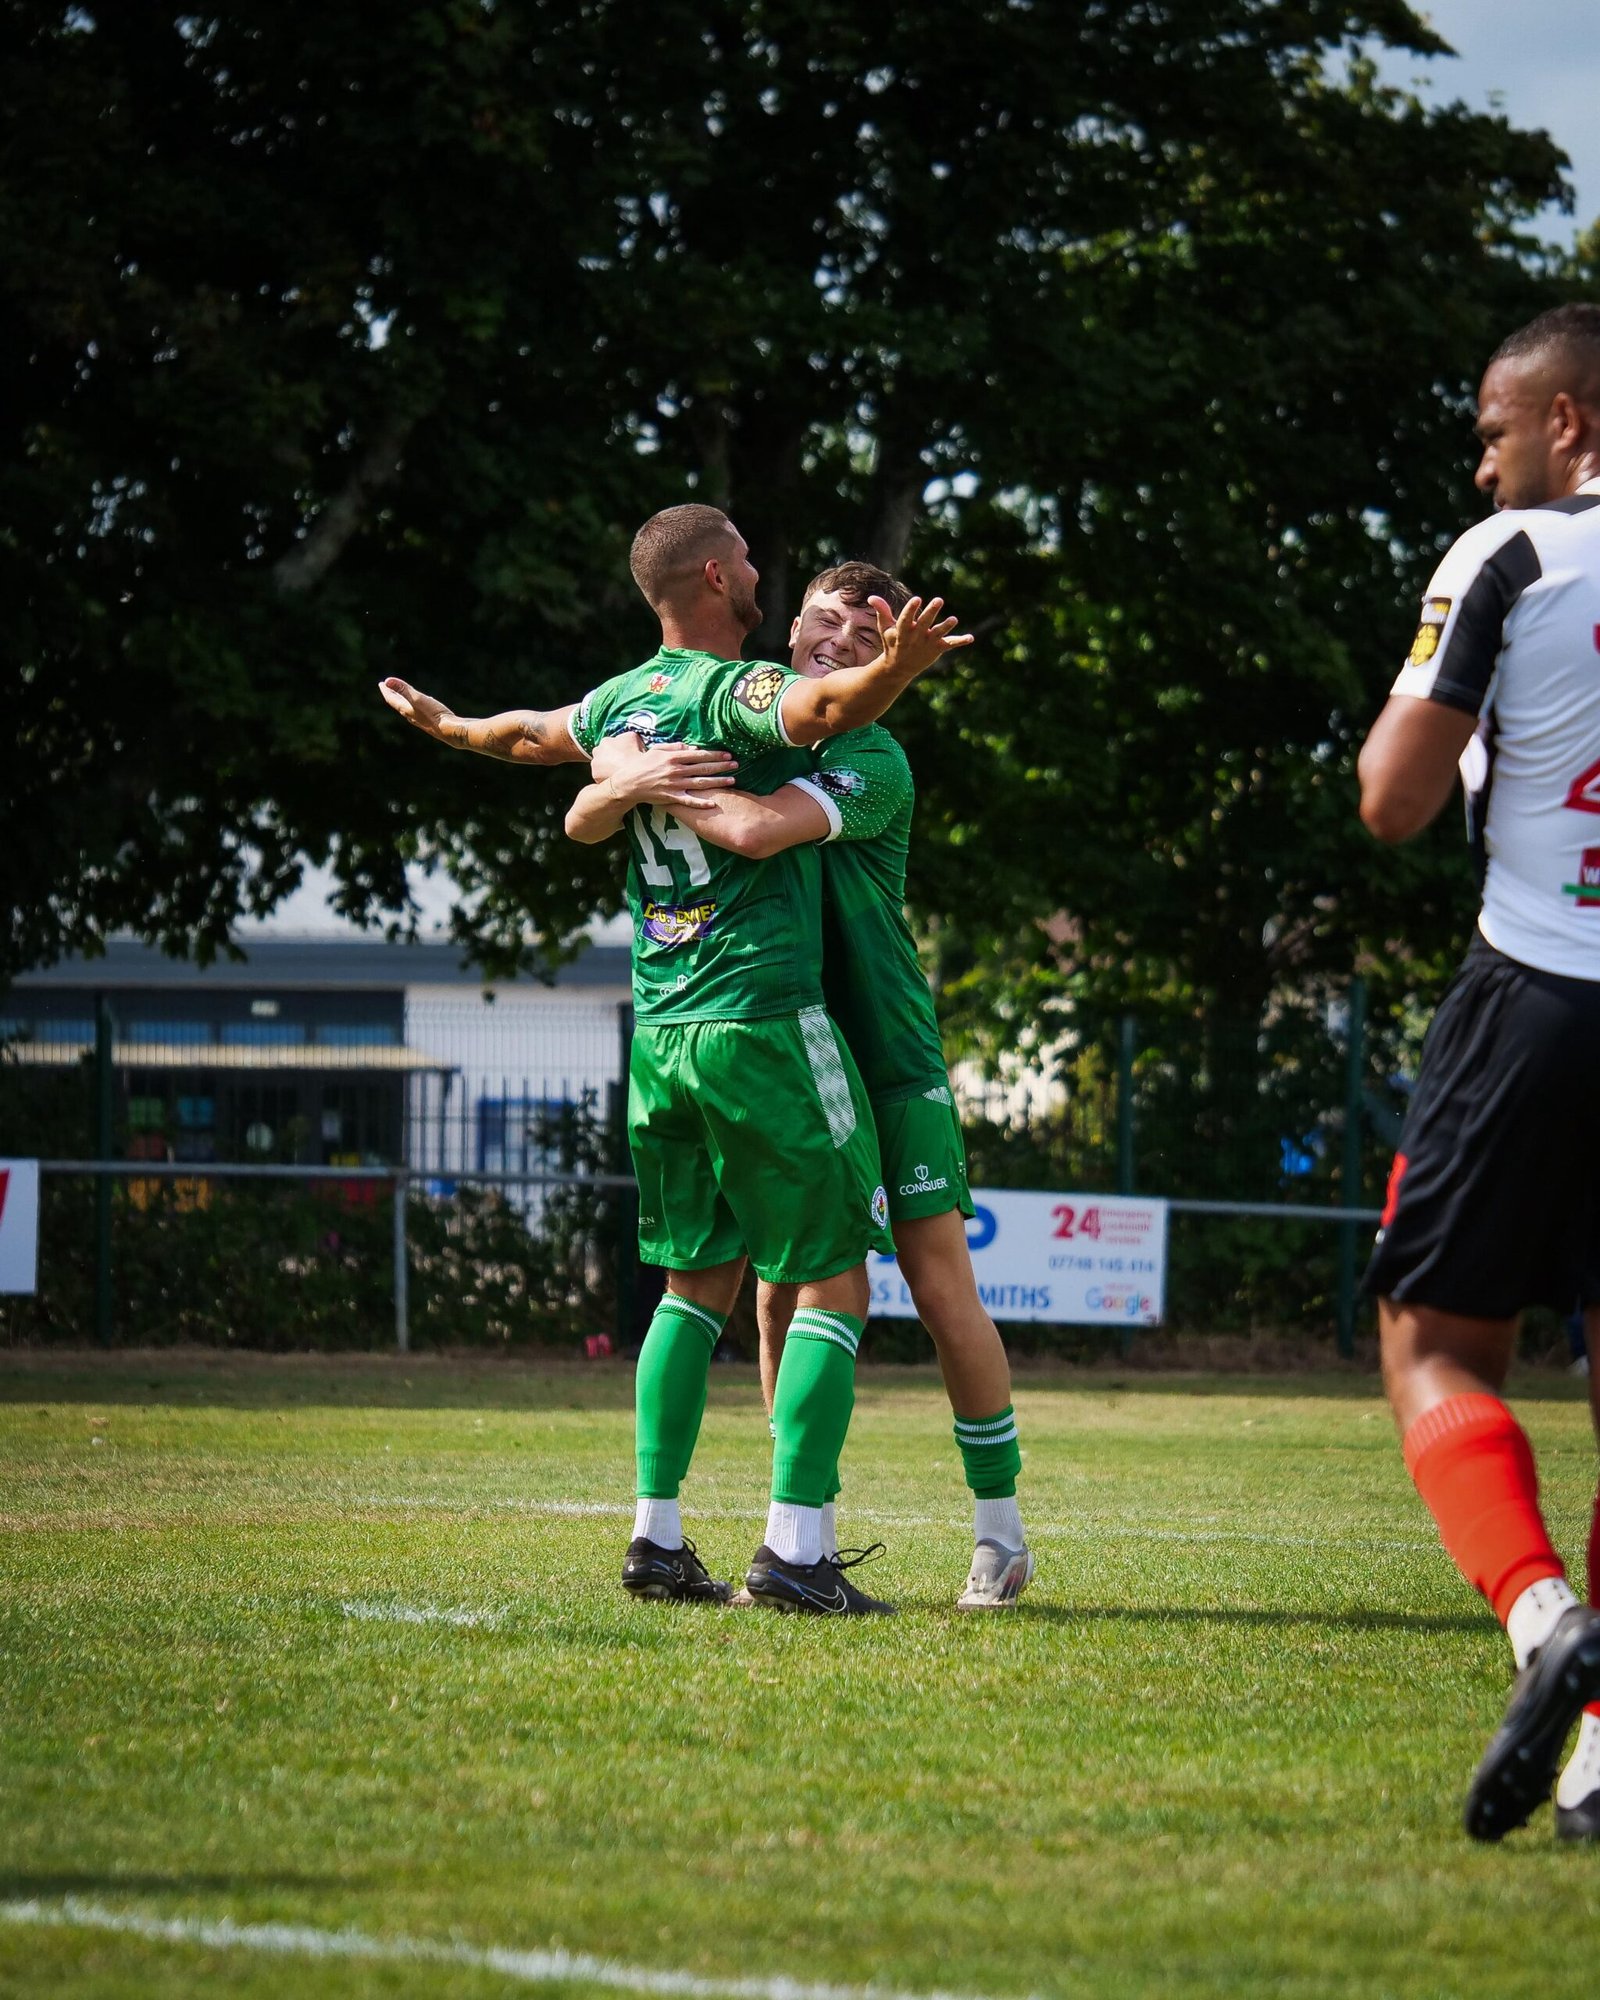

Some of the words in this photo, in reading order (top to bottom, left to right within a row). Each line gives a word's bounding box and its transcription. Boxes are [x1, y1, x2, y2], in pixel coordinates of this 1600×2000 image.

[900, 1177, 948, 1196] CONQUER
[1051, 1204, 1101, 1241] 24
[1085, 1286, 1151, 1316] Google
